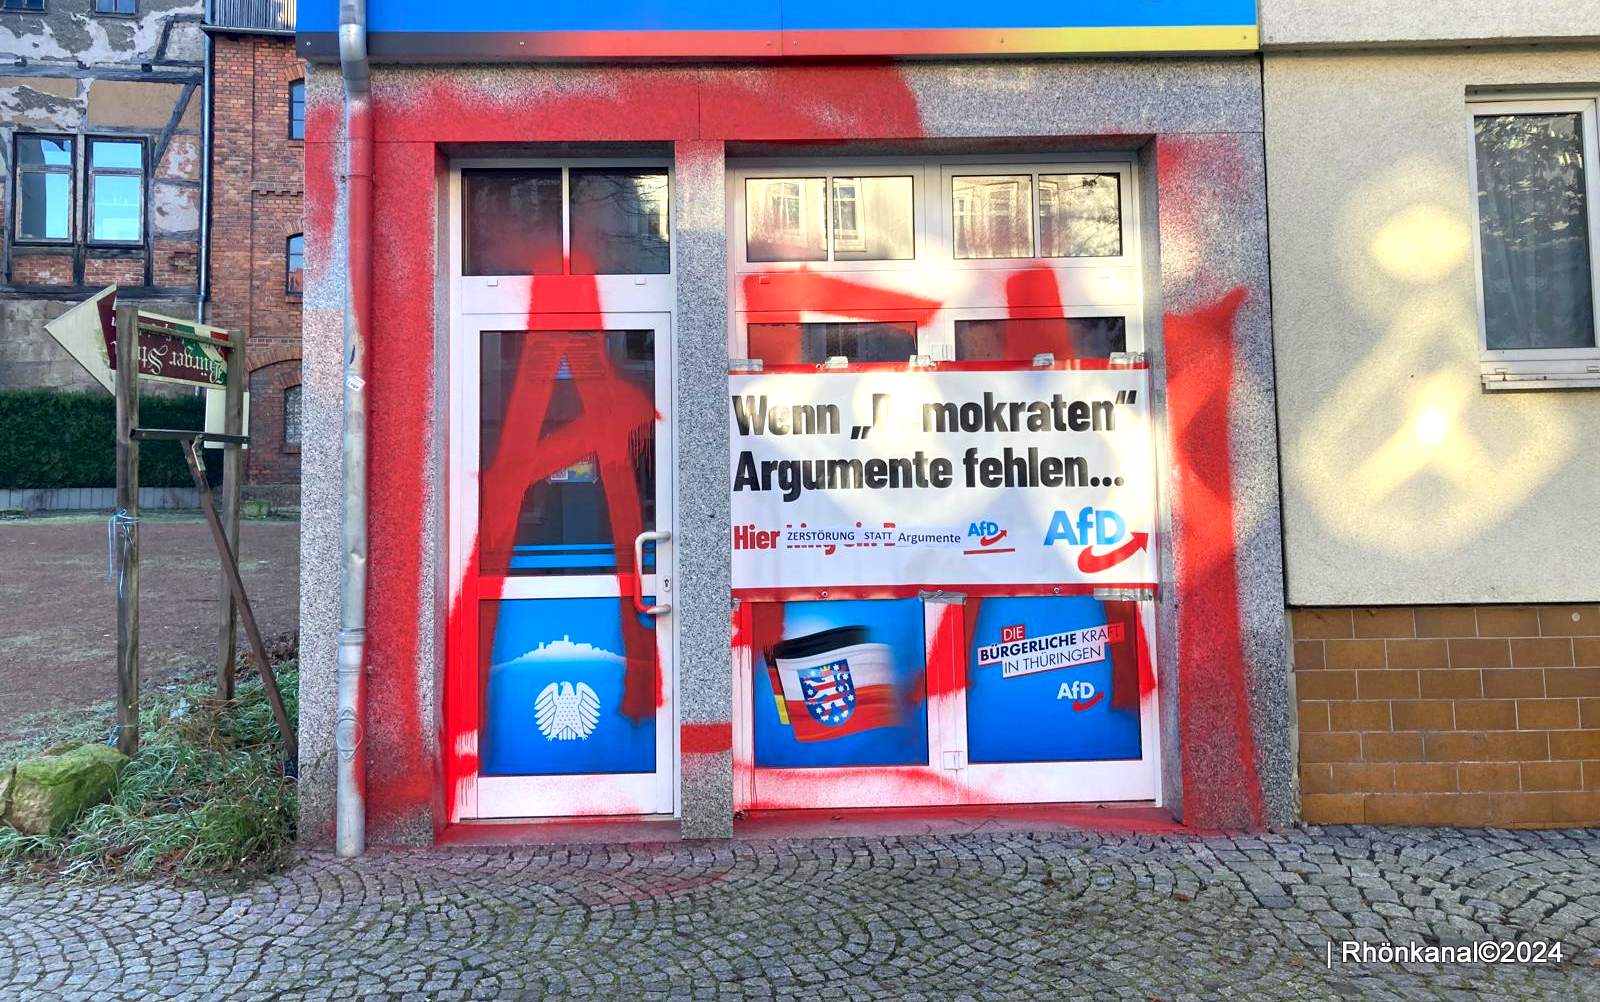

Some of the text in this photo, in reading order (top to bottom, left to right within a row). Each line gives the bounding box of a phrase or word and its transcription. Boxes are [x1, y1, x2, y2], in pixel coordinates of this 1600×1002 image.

[732, 393, 841, 437] Wenn
[733, 447, 1125, 503] Argumente fehlen...
[734, 521, 999, 550] Hier ZERSTÖRUNG STATT Argumente AfD
[1043, 506, 1126, 546] AfD
[980, 625, 1120, 662] BÜRGERLICHE KRAFT
[1004, 627, 1024, 641] DIE
[1004, 646, 1101, 674] IN THÜRINGEN
[1057, 680, 1095, 700] AfD
